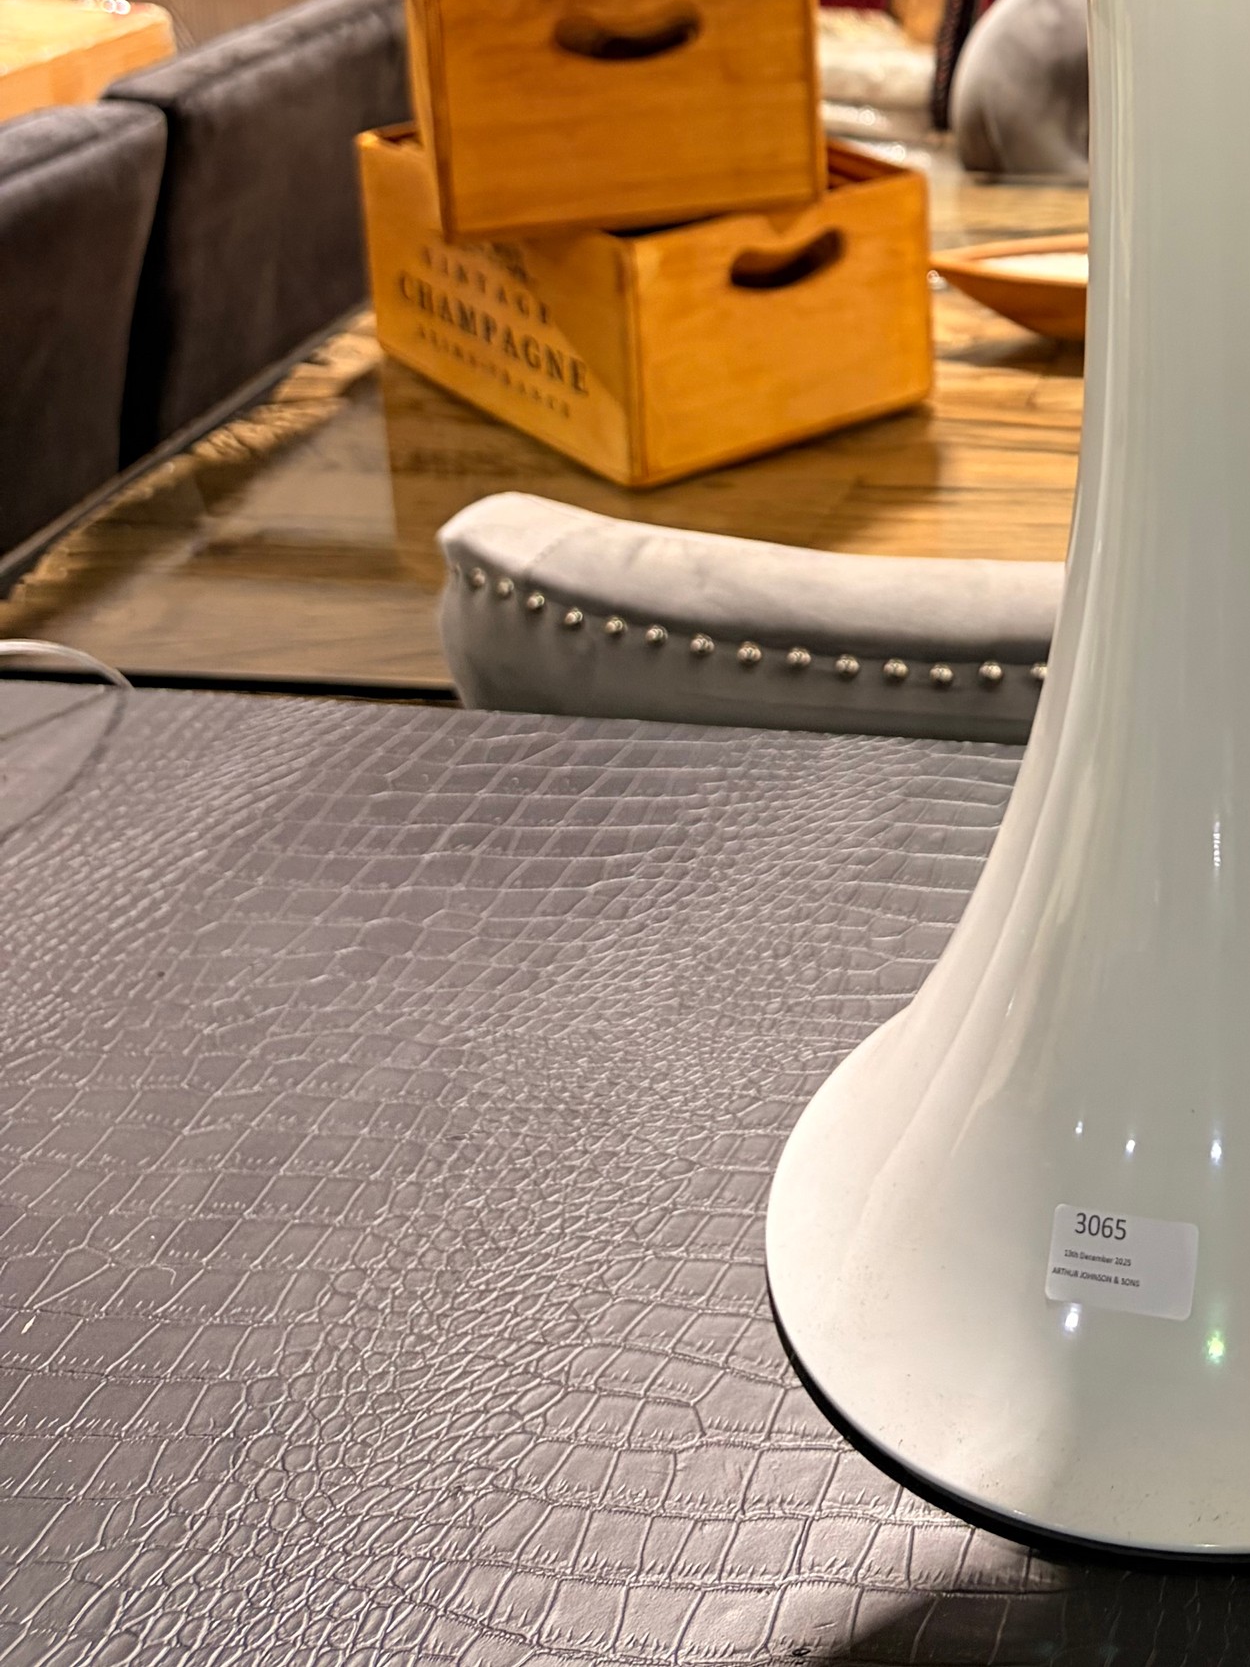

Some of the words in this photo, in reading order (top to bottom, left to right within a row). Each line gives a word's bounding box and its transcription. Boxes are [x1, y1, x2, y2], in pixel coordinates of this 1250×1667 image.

[398, 269, 591, 397] CHAMPAGNE
[1074, 1212, 1127, 1241] 3065
[1079, 1251, 1114, 1264] December
[1051, 1267, 1079, 1278] ARTHUR
[1079, 1271, 1112, 1283] JOHNSON
[1120, 1277, 1140, 1287] SONS
